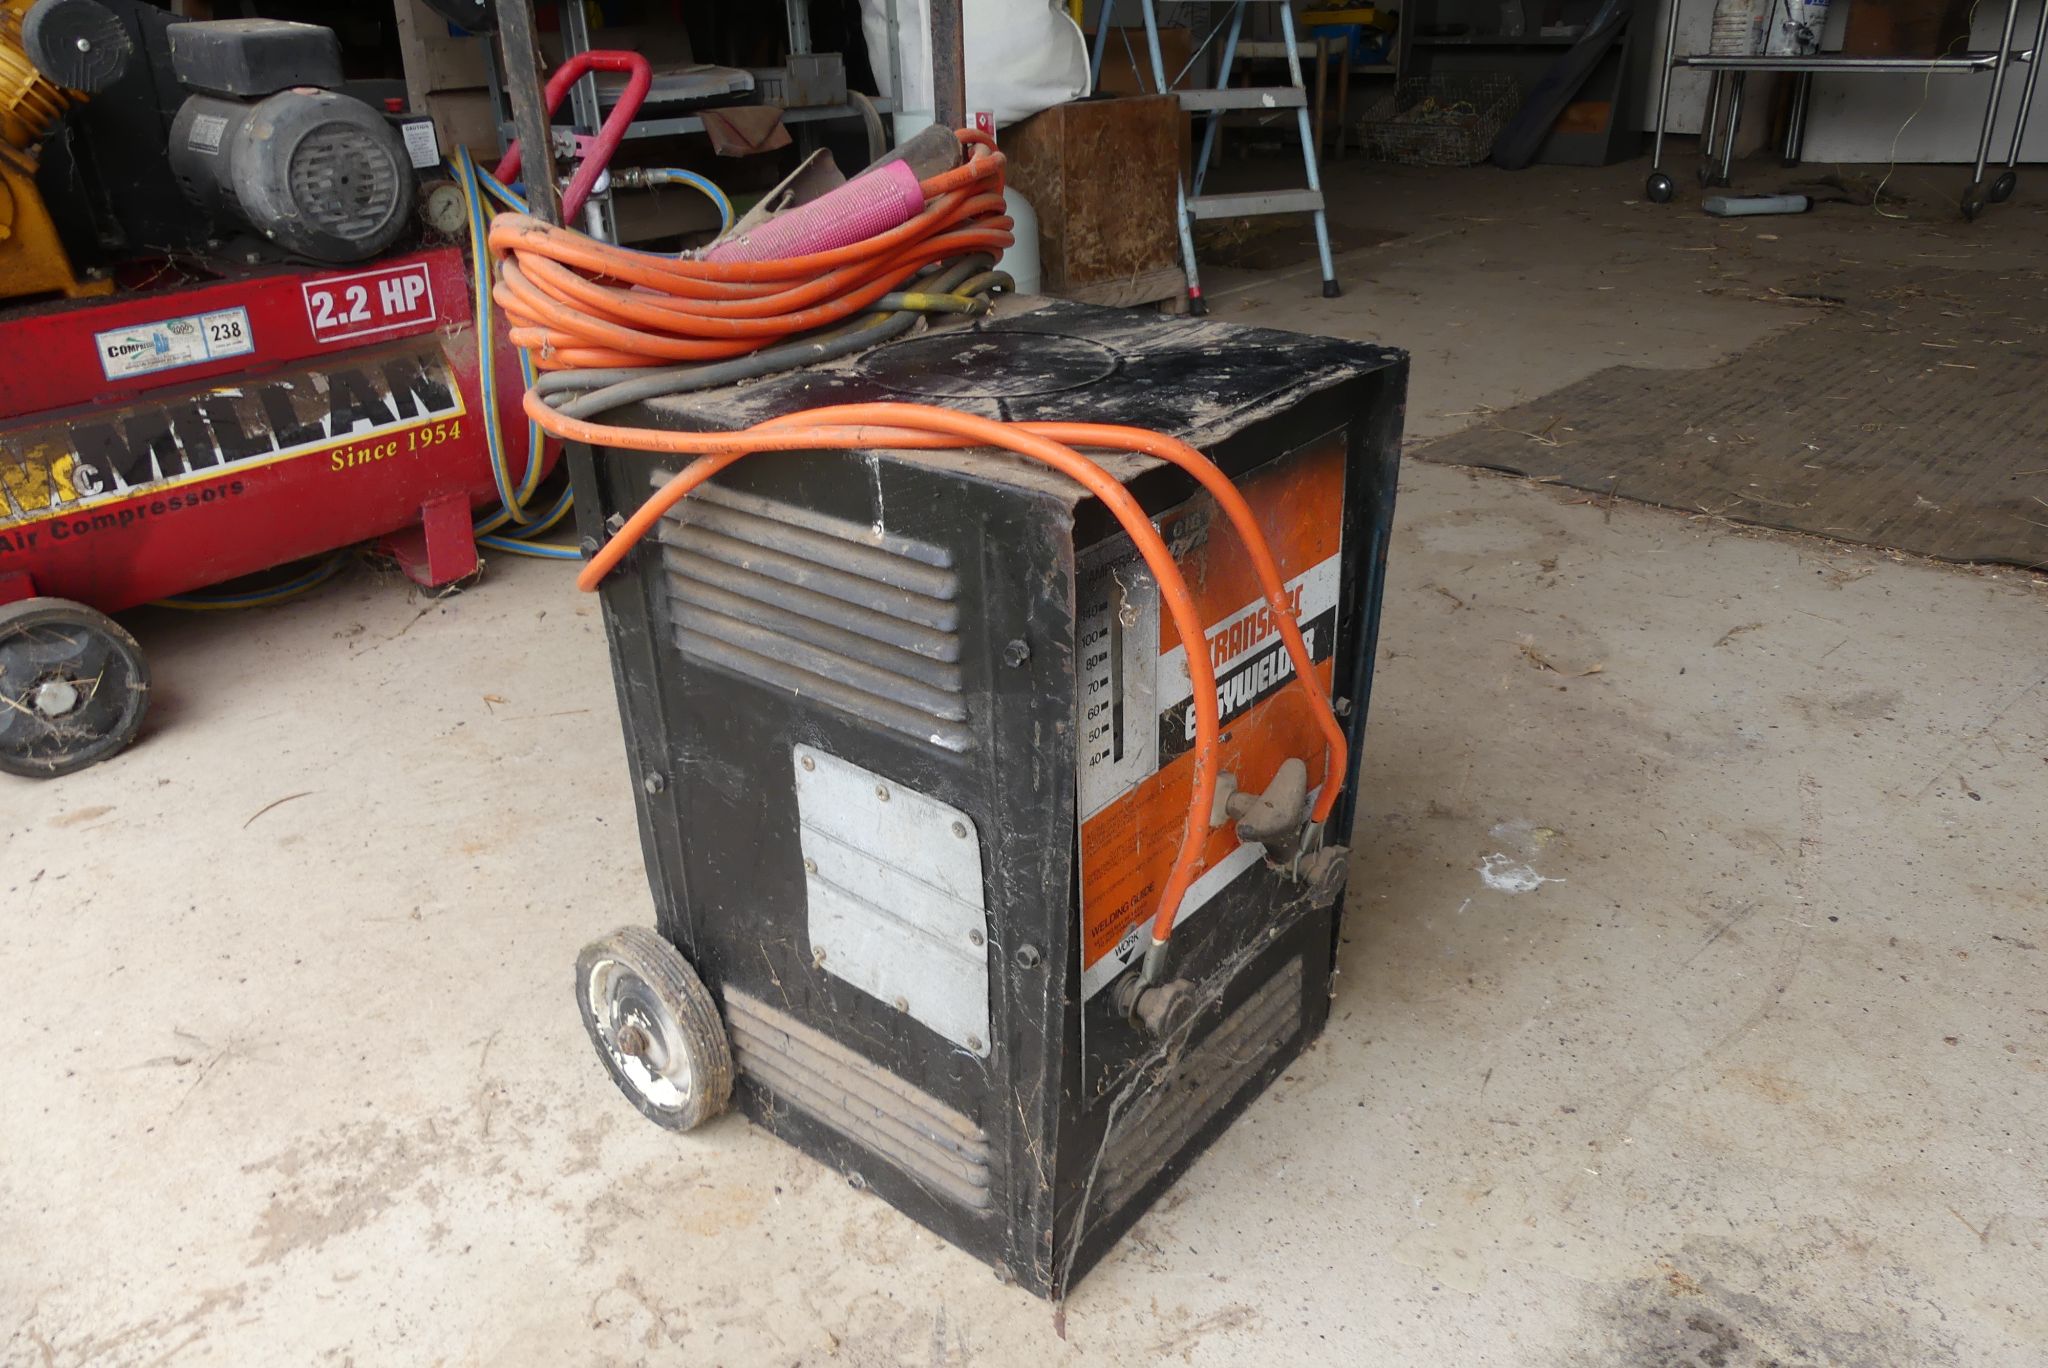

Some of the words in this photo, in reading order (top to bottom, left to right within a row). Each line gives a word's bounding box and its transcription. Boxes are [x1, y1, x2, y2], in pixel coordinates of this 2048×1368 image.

[311, 285, 371, 329] 2.2
[379, 274, 425, 316] HP
[211, 321, 241, 341] 238
[331, 441, 397, 471] Since
[408, 420, 461, 451] 1954
[0, 532, 38, 553] Air
[51, 479, 244, 541] Compressors
[1082, 630, 1098, 648] 100
[1086, 655, 1098, 671] 80
[1088, 680, 1099, 695] 70
[1088, 704, 1100, 720] 60
[1088, 727, 1100, 743] 50
[1089, 752, 1101, 767] 40
[1091, 901, 1130, 937] WELDING
[1114, 930, 1139, 956] WORK
